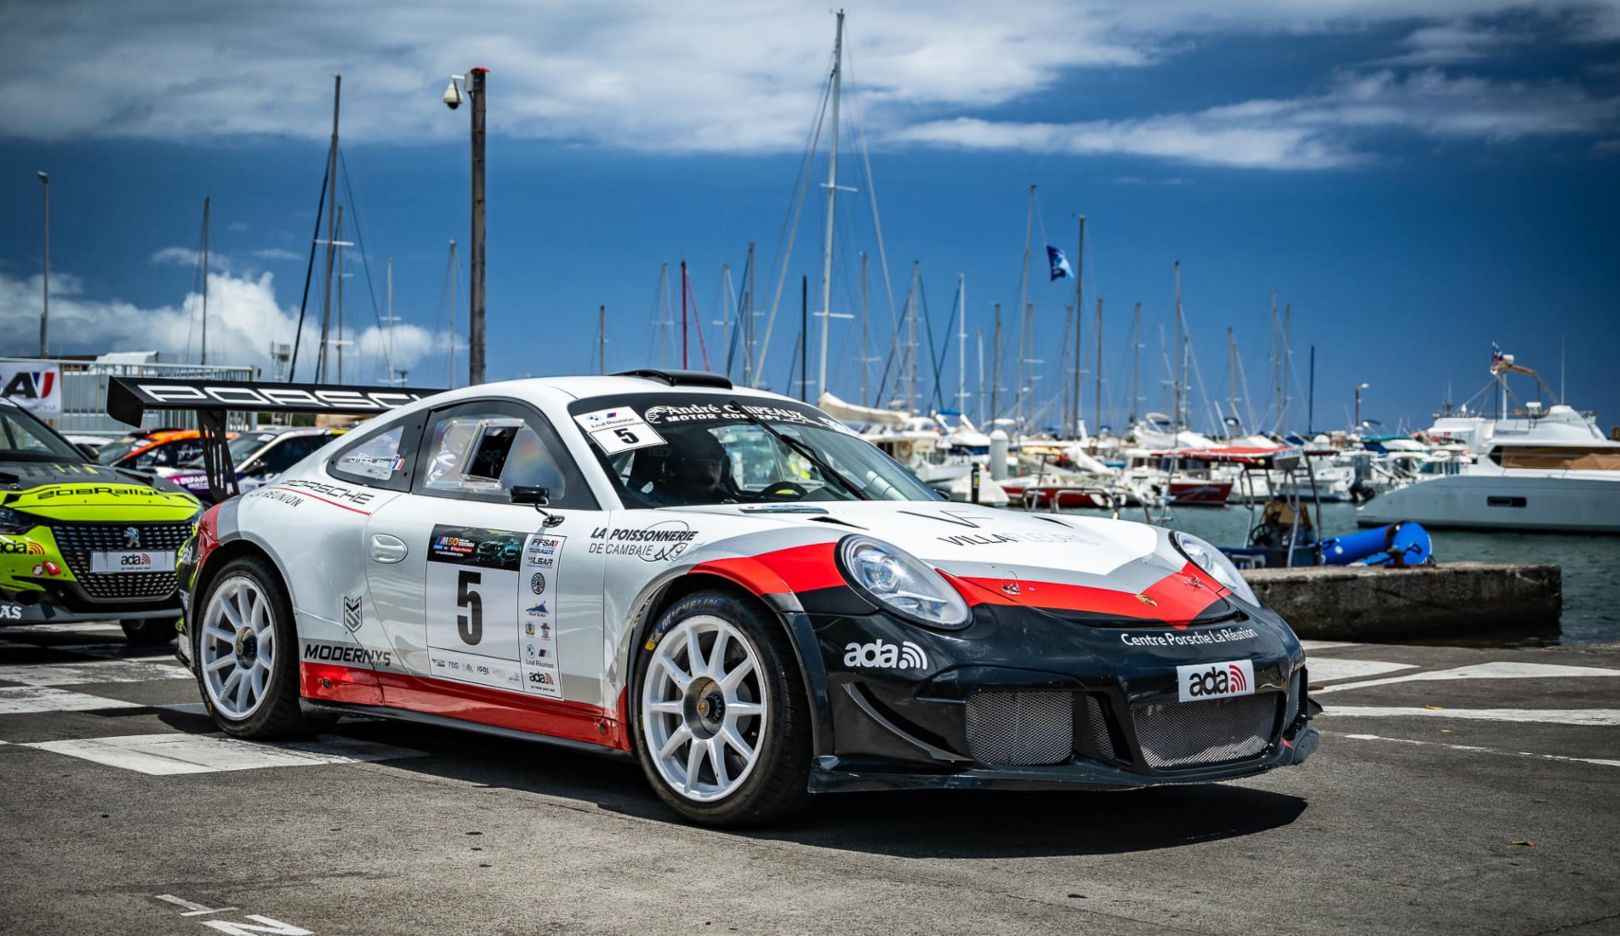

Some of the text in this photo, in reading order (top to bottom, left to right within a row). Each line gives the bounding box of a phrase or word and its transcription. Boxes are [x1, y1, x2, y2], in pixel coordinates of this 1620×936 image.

[138, 384, 422, 408] PORSC
[665, 403, 721, 415] André
[666, 413, 718, 422] MOTOR
[613, 427, 640, 444] 5
[590, 527, 699, 542] LA POISSONNERIE
[588, 542, 654, 556] DE CAMBAIE
[120, 554, 141, 565] ada
[457, 570, 483, 645] 5
[1121, 627, 1258, 647] Centre Porsche La Réunion
[304, 644, 391, 666] MODERNYS
[843, 639, 899, 669] ada
[529, 672, 545, 684] ada
[1189, 666, 1229, 697] ada
